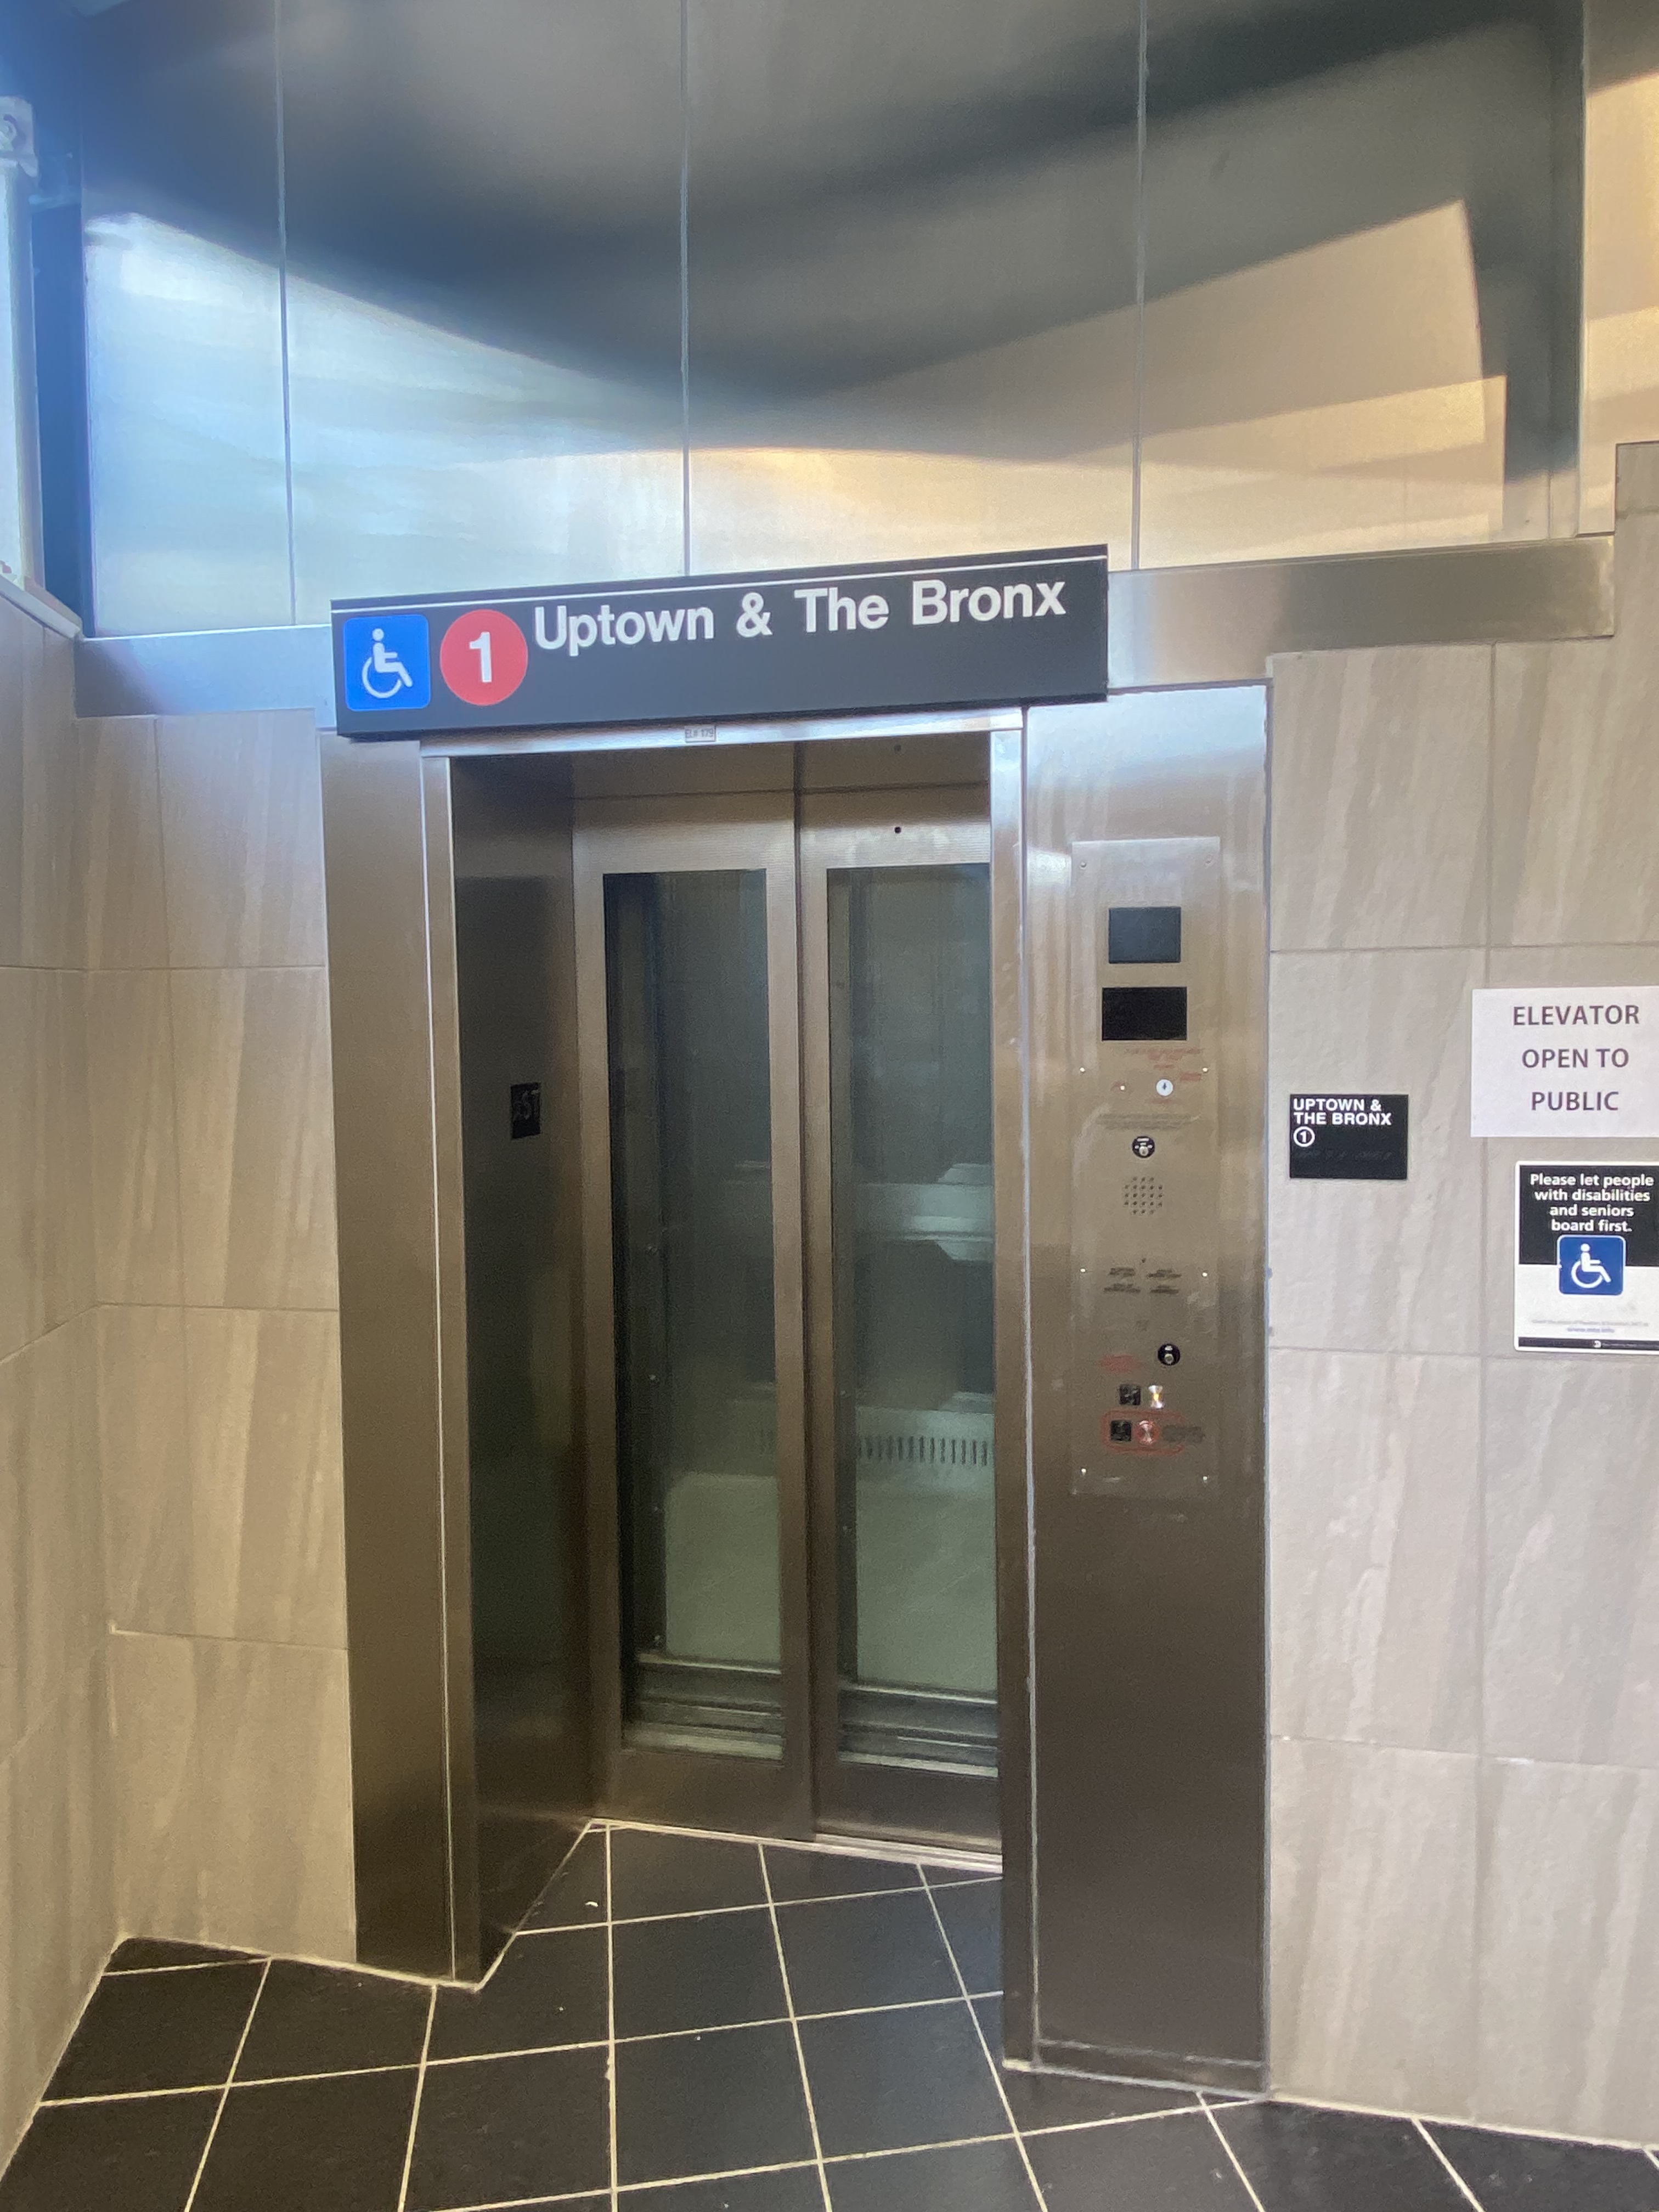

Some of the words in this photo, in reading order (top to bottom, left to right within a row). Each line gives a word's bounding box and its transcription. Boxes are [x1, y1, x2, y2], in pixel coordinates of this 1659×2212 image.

[469, 631, 492, 683] 1
[535, 605, 714, 657] Uptown
[736, 592, 773, 637] &
[794, 587, 889, 633] The
[912, 580, 1066, 626] Bronx
[1513, 1005, 1640, 1026] ELEVATOR
[1522, 1048, 1588, 1068] OPEN
[1595, 1048, 1629, 1068] TO
[1293, 1098, 1365, 1111] UPTOWN
[1370, 1099, 1382, 1111] &
[1531, 1091, 1620, 1111] PUBLIC
[1293, 1112, 1327, 1125] THE
[1331, 1113, 1392, 1125] BRONX
[1300, 1131, 1307, 1143] 1
[1530, 1173, 1576, 1186] Please
[1580, 1173, 1600, 1186] let
[1604, 1173, 1655, 1188] people
[1534, 1189, 1567, 1201] with
[1572, 1189, 1651, 1202] disabilities
[1550, 1204, 1577, 1216] and
[1581, 1205, 1634, 1217] seniors
[1551, 1219, 1594, 1232] board
[1598, 1219, 1633, 1232] first.
